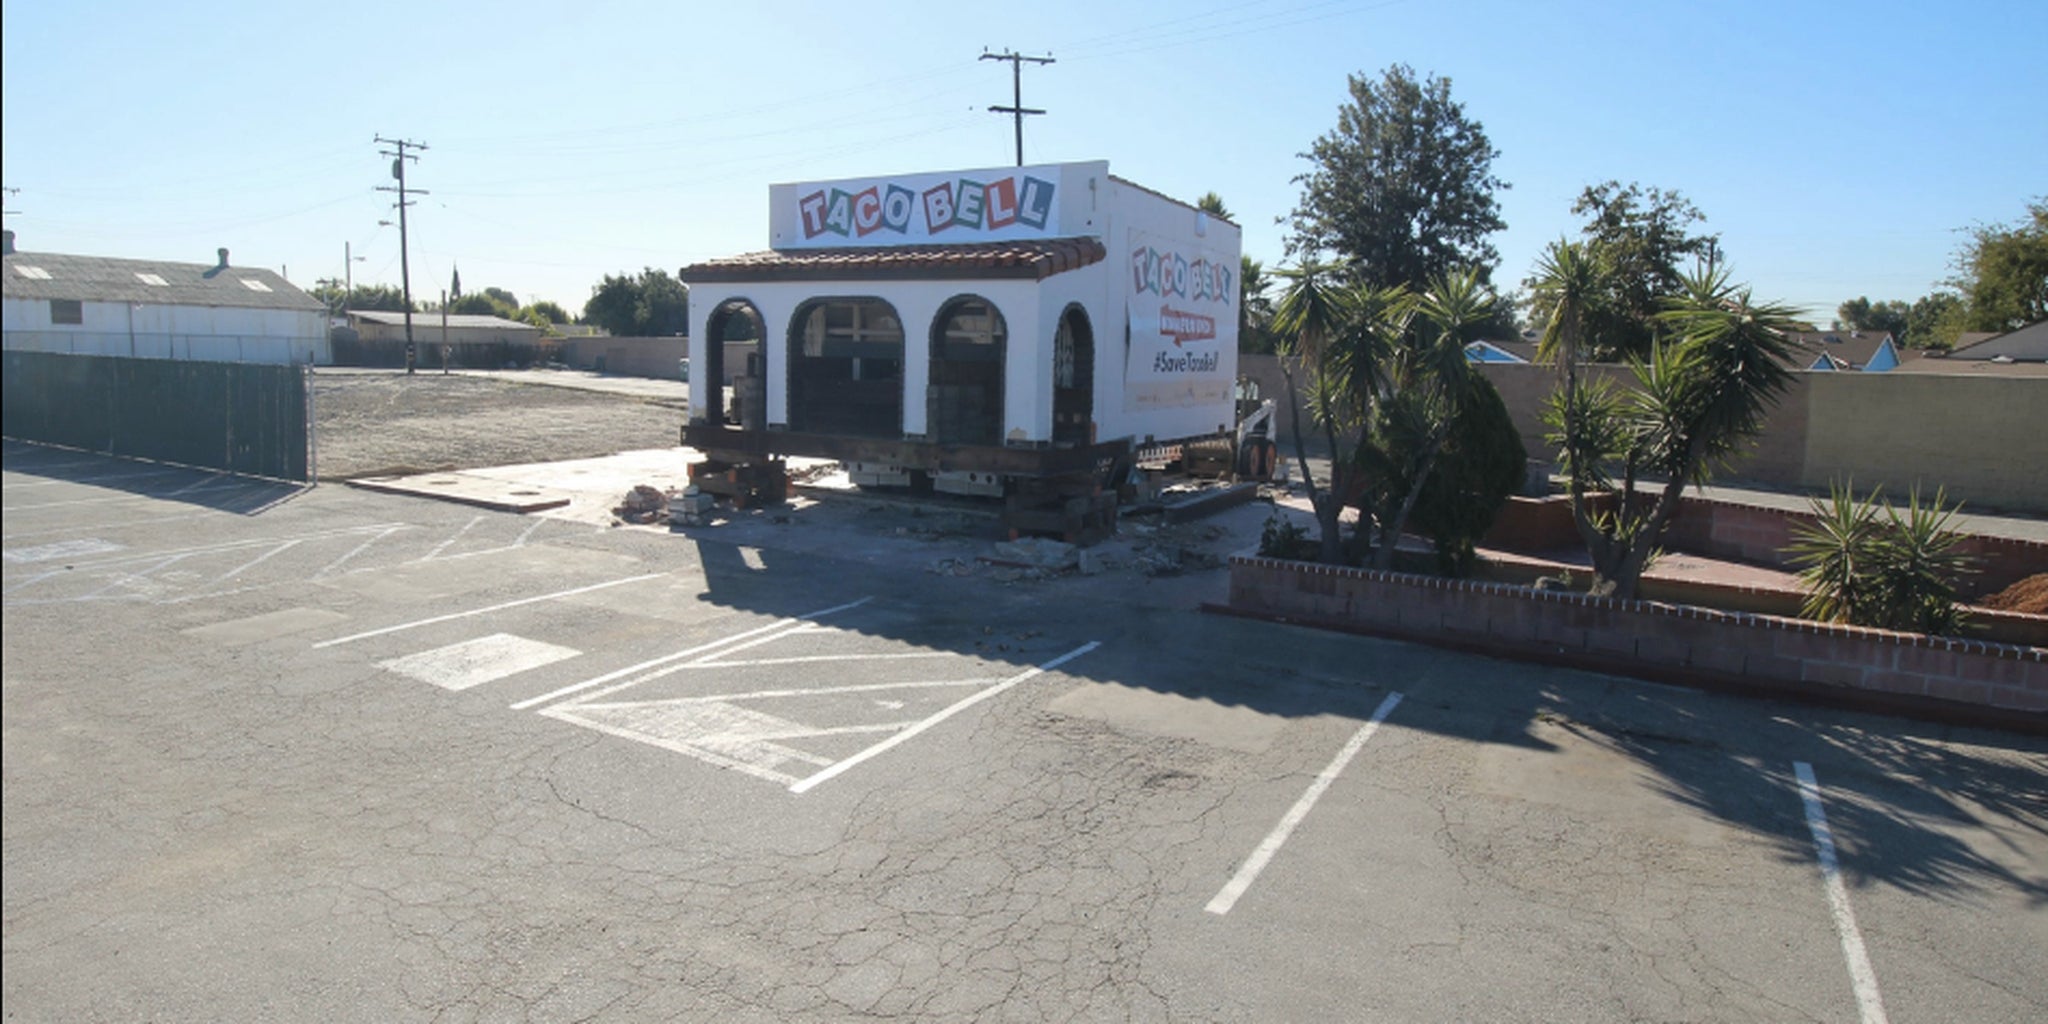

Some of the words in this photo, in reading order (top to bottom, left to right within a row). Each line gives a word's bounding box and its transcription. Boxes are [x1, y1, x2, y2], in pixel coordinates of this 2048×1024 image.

[802, 188, 912, 235] TACO
[925, 180, 1049, 231] BELL
[1134, 251, 1187, 296] TACO
[1191, 261, 1230, 302] BELL
